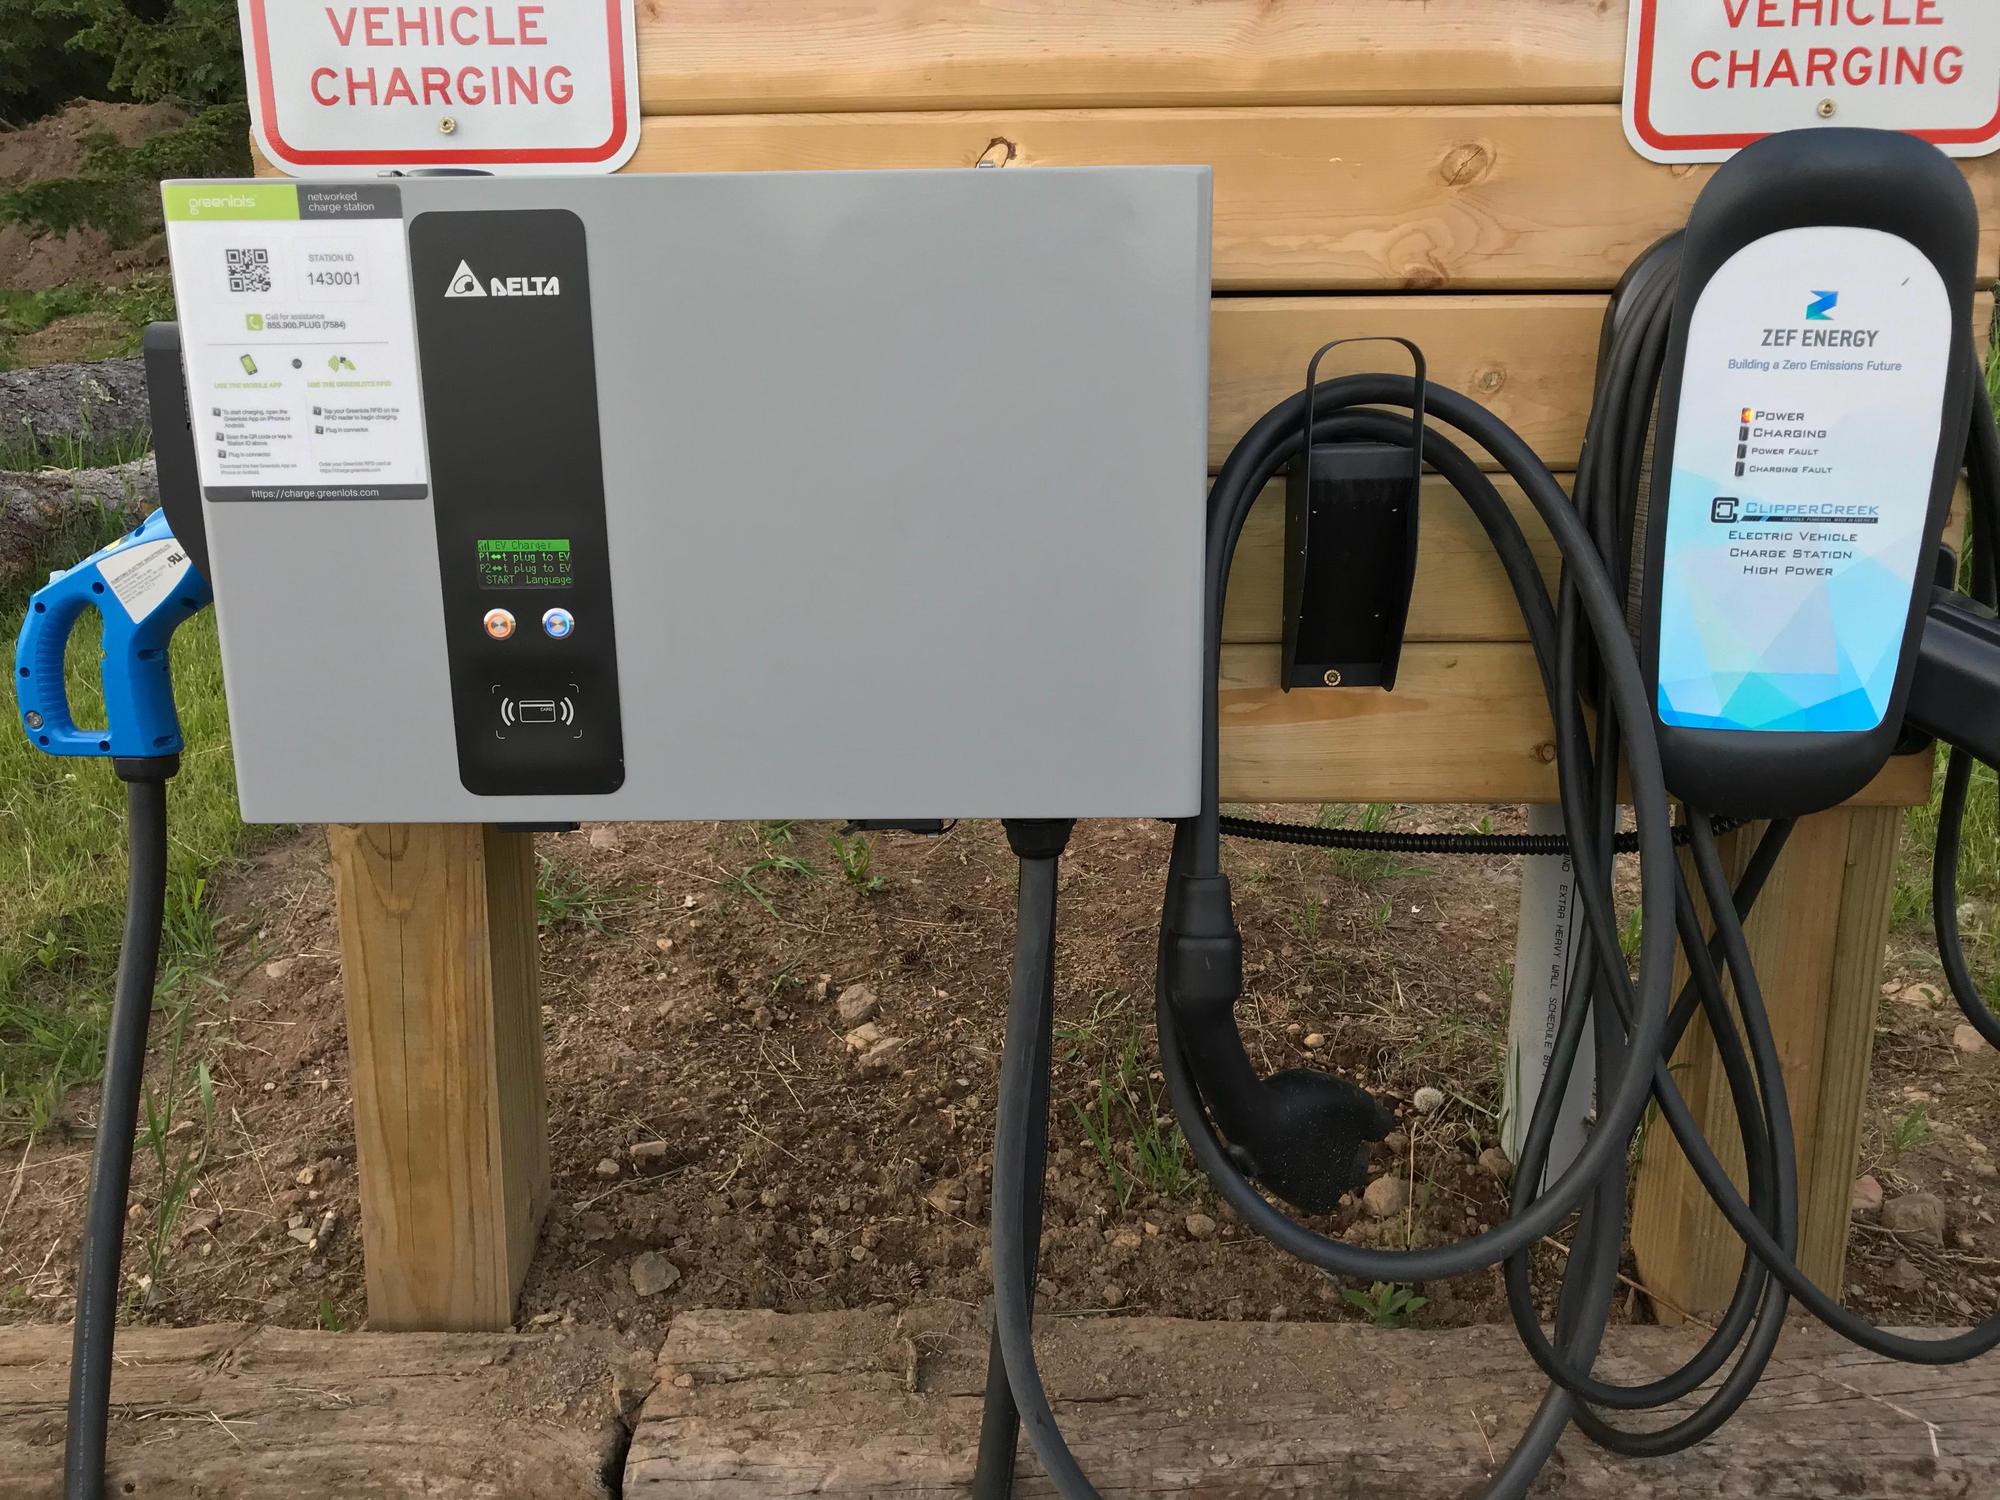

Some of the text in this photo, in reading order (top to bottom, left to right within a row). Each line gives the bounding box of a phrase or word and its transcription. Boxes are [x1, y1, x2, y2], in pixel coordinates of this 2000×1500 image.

[1723, 0, 1944, 28] VEHICLE
[325, 6, 548, 46] VEHICLE
[1690, 45, 1964, 89] CHARGING
[310, 66, 574, 106] CHARGING
[307, 192, 357, 201] networked
[188, 194, 256, 215] greenlots
[308, 202, 375, 212] charge station
[308, 254, 354, 262] STATION ID
[307, 271, 360, 286] 143001
[490, 276, 560, 296] DELTA
[1761, 329, 1880, 347] ZEF ENERGY
[1728, 359, 1902, 372] Building a Zero Emissions Future
[1755, 411, 1805, 421] POWER
[1753, 428, 1827, 438] CHARGING
[1749, 465, 1799, 473] CHARGING
[251, 489, 379, 499] https://charge.greenlots.com
[1728, 530, 1858, 542] ELECTRIC VEHICLE
[495, 540, 551, 550] EV Charger
[513, 552, 536, 563] plug
[542, 552, 553, 561] to
[558, 552, 570, 561] EV
[1729, 548, 1852, 559] CHARGE STATION
[514, 564, 537, 574] plug
[543, 564, 554, 572] to
[559, 564, 571, 572] EV
[1743, 565, 1833, 576] HIGH POWER
[486, 575, 572, 585] START Language
[1557, 884, 1568, 919] EXTRA
[1553, 924, 1564, 958] HEAVY
[1549, 964, 1559, 989] WALL
[1544, 997, 1557, 1049] SCHEDULE
